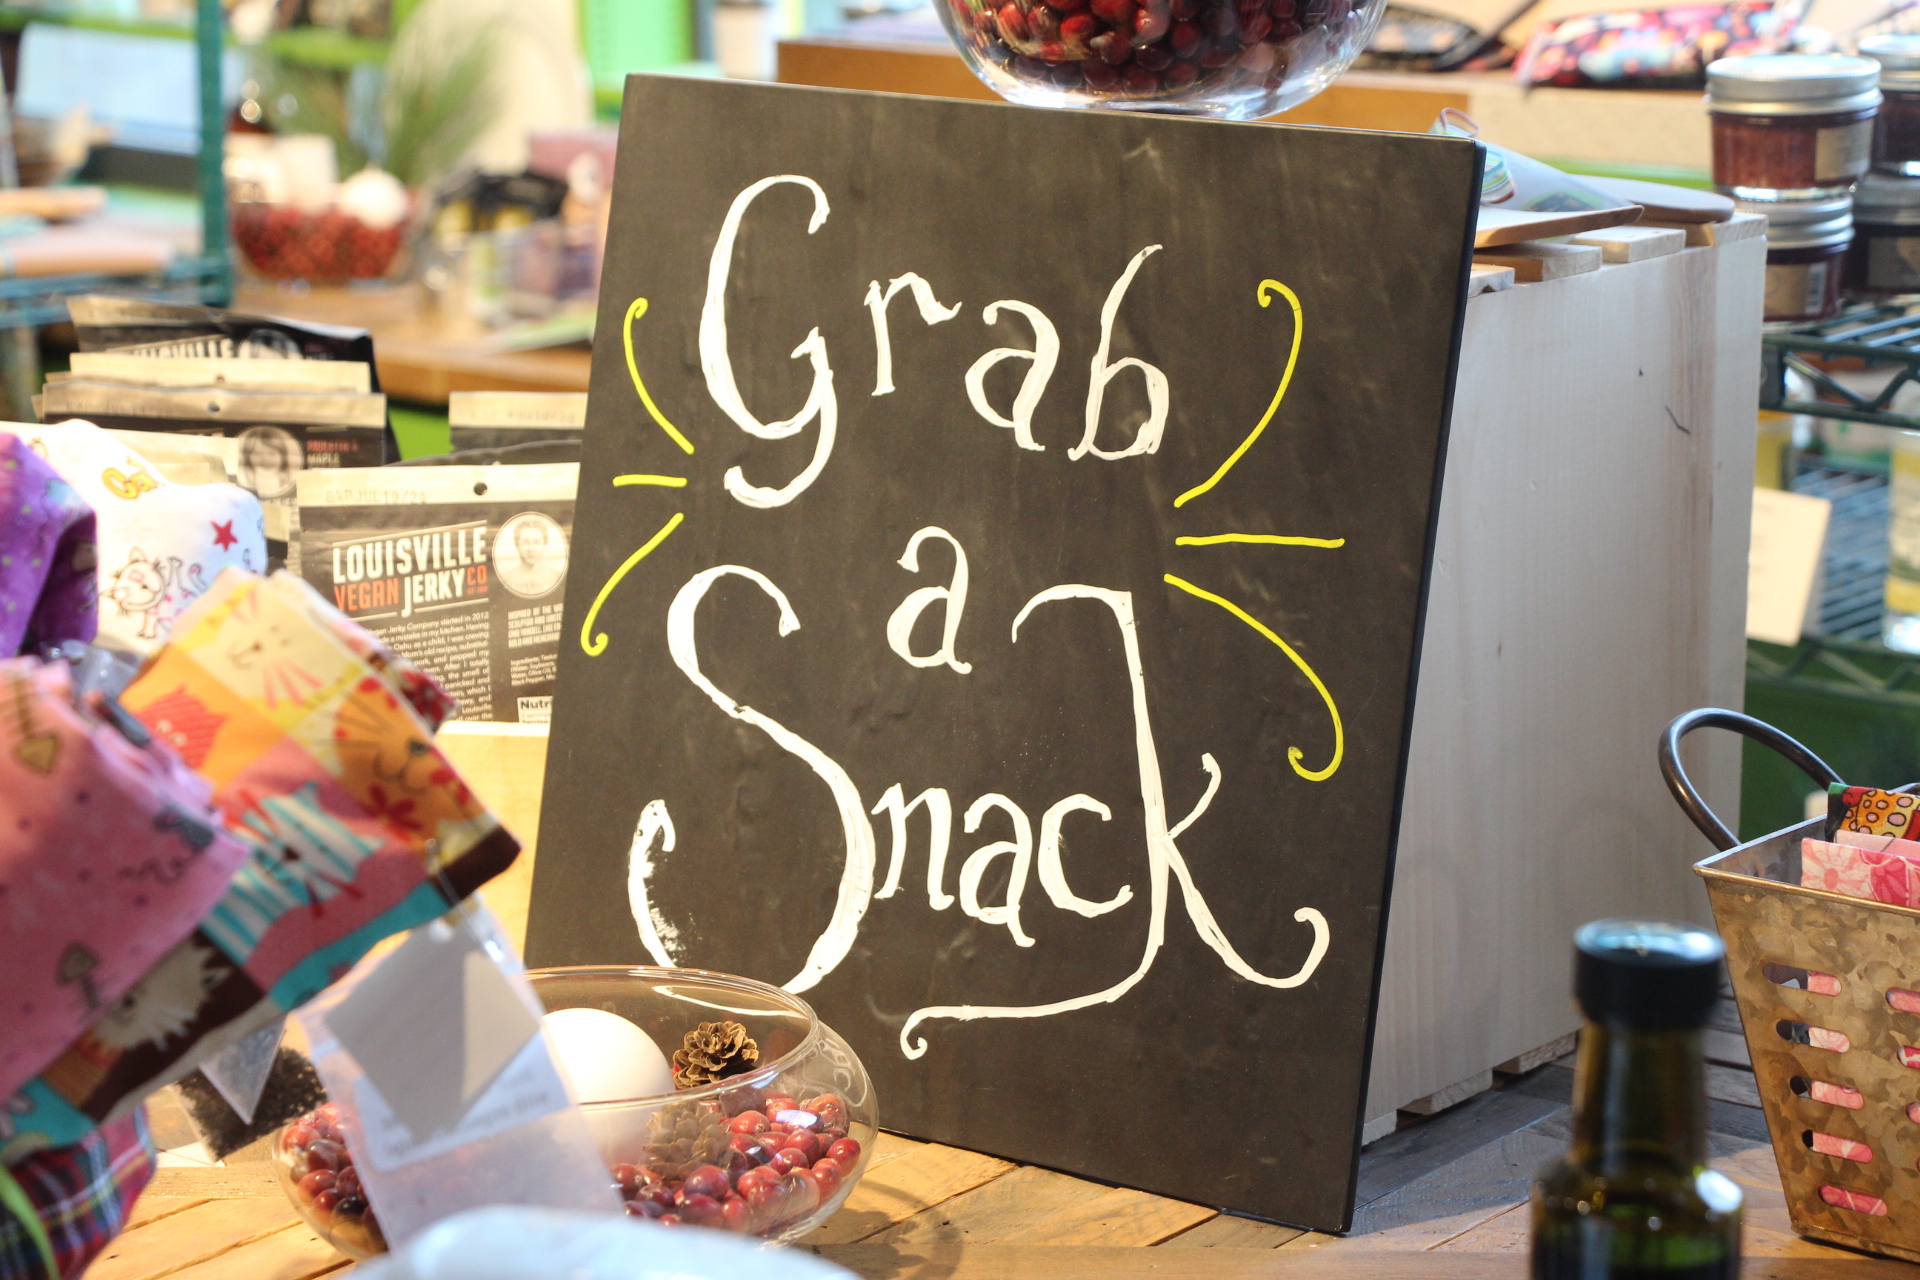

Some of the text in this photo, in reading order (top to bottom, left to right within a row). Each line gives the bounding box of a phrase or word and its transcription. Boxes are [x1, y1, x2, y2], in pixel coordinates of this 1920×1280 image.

[698, 174, 1169, 507] Grab
[326, 489, 353, 503] EXP
[332, 526, 488, 585] LOUISVILLE
[333, 564, 488, 618] VEGAN JERKY CO
[887, 525, 972, 676] a
[388, 625, 406, 634] Jerky
[407, 620, 439, 632] Company
[440, 615, 463, 626] started
[464, 614, 471, 622] in
[472, 611, 490, 621] 2012
[396, 631, 421, 641] mistake
[428, 629, 440, 638] my
[466, 622, 490, 632] Having
[393, 642, 412, 651] Oahu
[451, 635, 464, 643] was
[465, 631, 490, 642] craving
[424, 647, 435, 656] old
[433, 655, 447, 664] and
[449, 650, 476, 662] popped
[479, 649, 489, 657] my
[444, 662, 460, 671] After
[469, 657, 490, 667] totally
[447, 671, 459, 680] the
[462, 668, 480, 677] smell
[482, 666, 490, 674] of
[444, 678, 475, 690] panicked
[477, 675, 490, 684] and
[467, 685, 486, 695] which
[478, 694, 491, 703] and
[461, 703, 493, 714] Louisville
[481, 712, 493, 720] the
[627, 564, 1330, 1059] Snack
